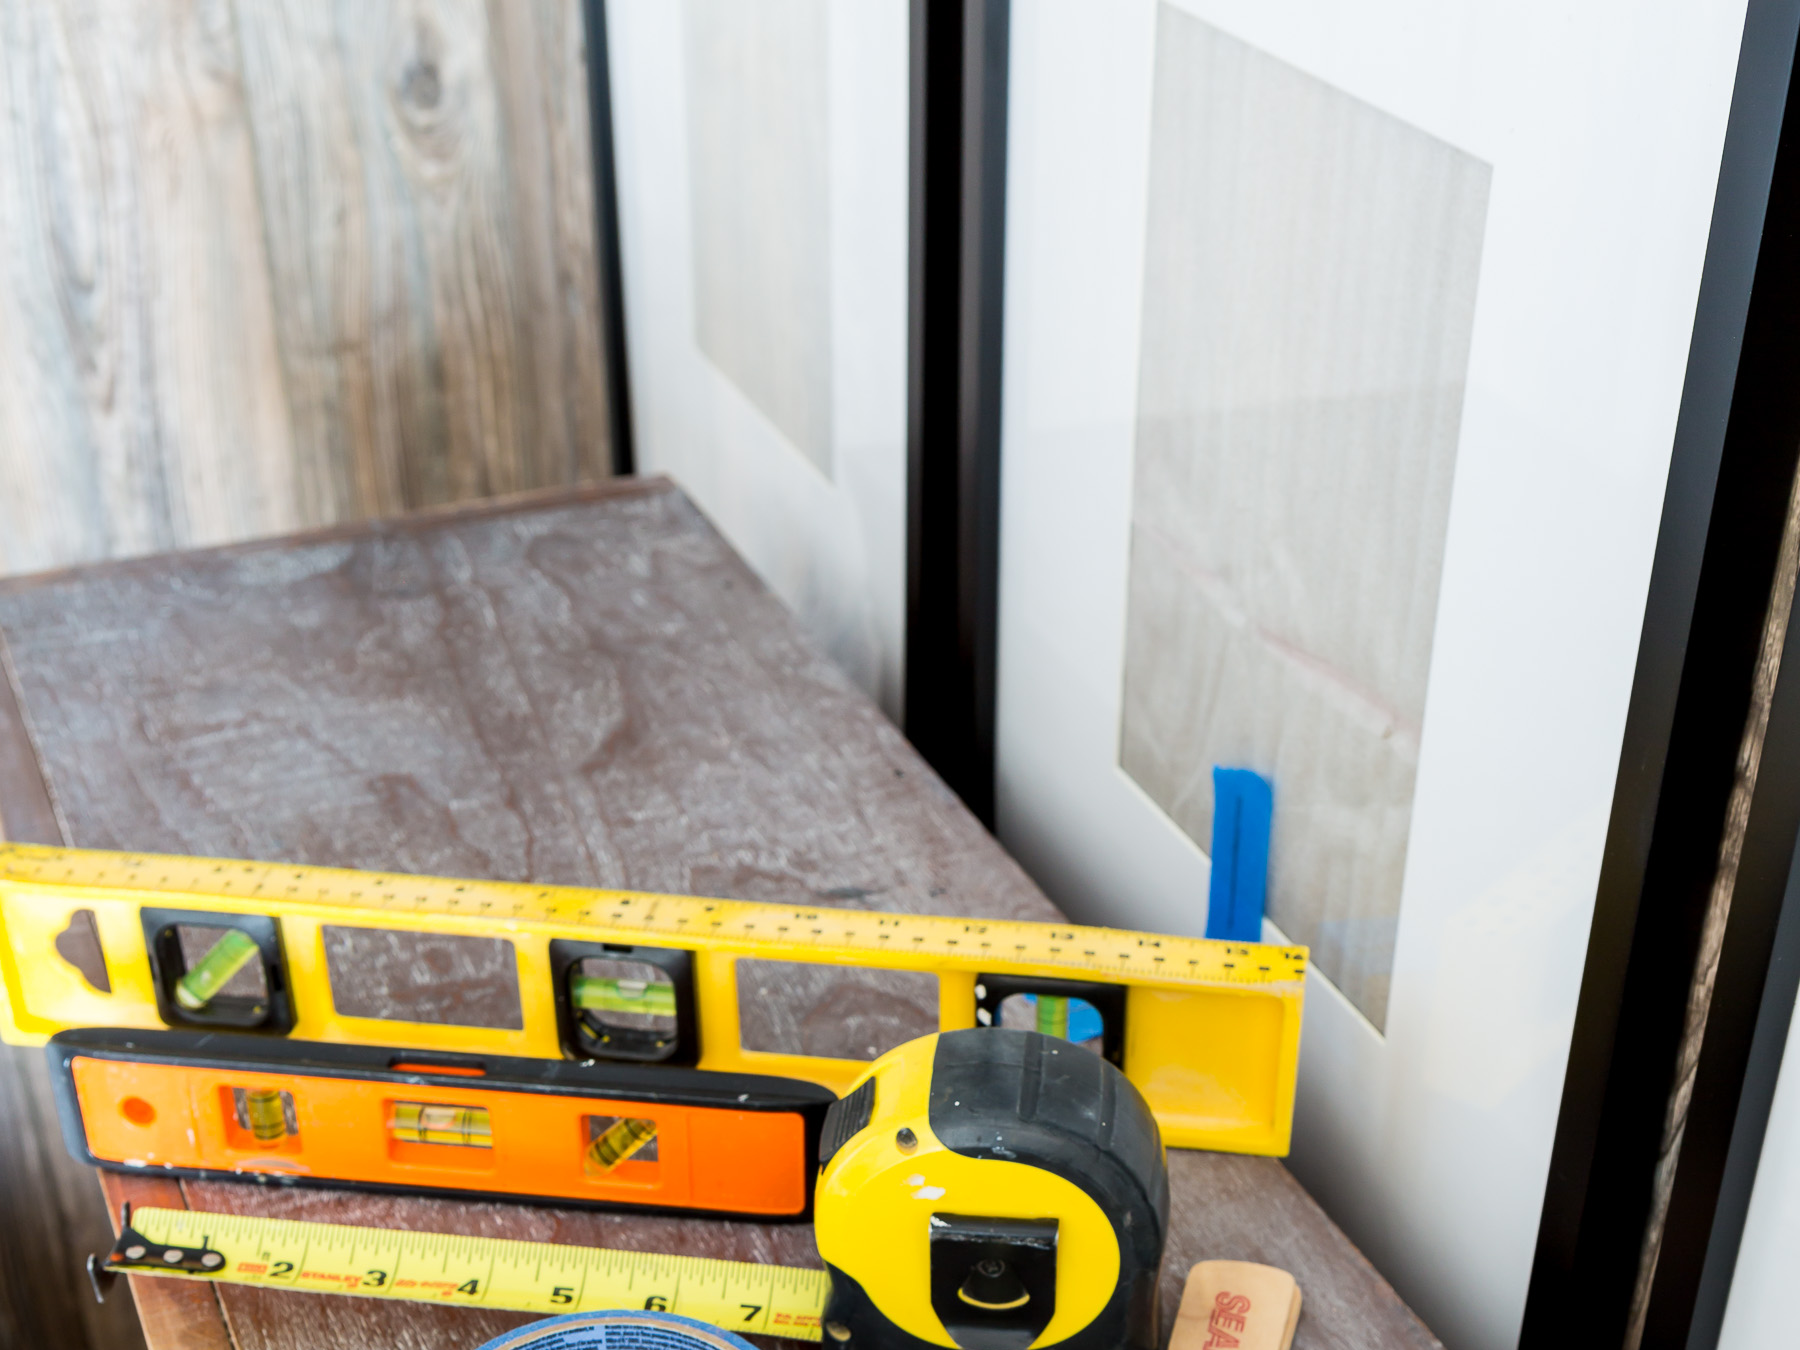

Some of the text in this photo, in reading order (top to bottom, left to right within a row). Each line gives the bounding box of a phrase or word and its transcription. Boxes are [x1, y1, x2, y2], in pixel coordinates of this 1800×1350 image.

[270, 1261, 294, 1278] 2
[363, 1270, 388, 1287] 3
[457, 1279, 480, 1296] 4
[550, 1286, 575, 1304] 5
[643, 1296, 668, 1312] 6
[739, 1304, 762, 1322] 7
